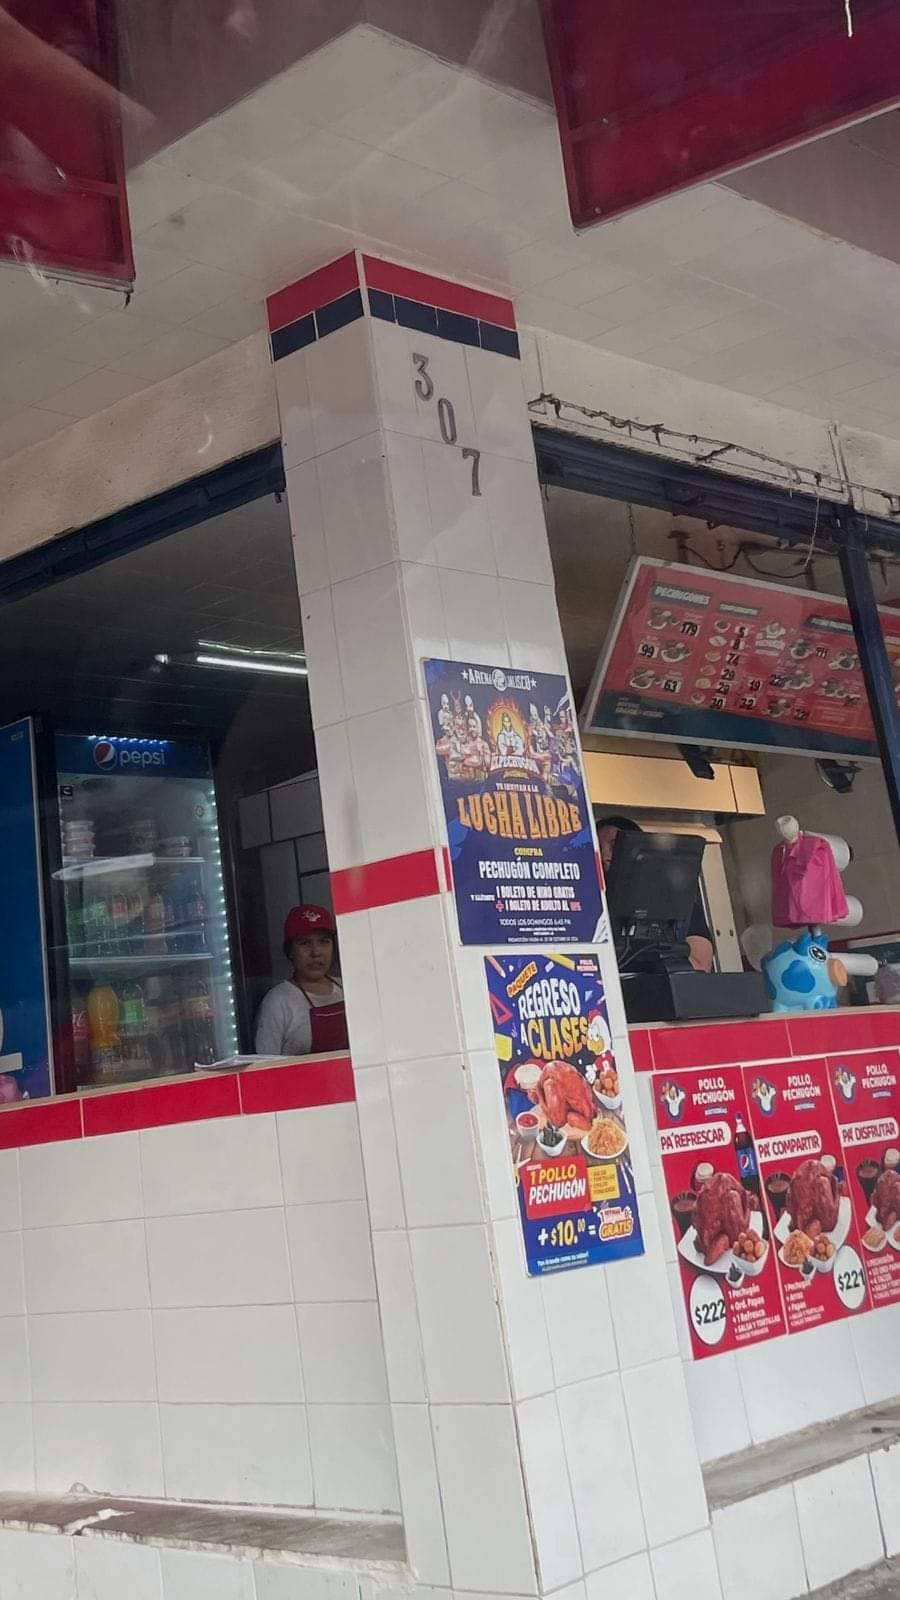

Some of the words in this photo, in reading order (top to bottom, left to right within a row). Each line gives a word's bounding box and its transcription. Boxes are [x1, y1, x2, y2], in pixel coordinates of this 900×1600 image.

[681, 622, 698, 636] 179
[641, 644, 655, 658] 99
[469, 668, 493, 685] ARENA
[664, 680, 678, 693] 63
[119, 746, 165, 768] pepsi
[457, 791, 528, 839] LUCHA
[525, 792, 583, 839] LIBRE
[479, 857, 531, 879] PECHUGÓN
[532, 862, 580, 880] COMPLETO
[526, 886, 536, 898] DE
[532, 900, 540, 911] DE
[509, 963, 537, 995] PAQUETE
[518, 978, 580, 1020] REGRESO
[520, 1023, 528, 1046] A
[528, 1017, 589, 1060] CLASES
[866, 1063, 889, 1076] POLLO
[698, 1076, 725, 1090] POLLO
[787, 1074, 812, 1087] POLLO
[675, 1128, 725, 1148] REFRESCAR
[855, 1122, 896, 1140] DISFRUTAR
[772, 1135, 820, 1155] COMPARTIR
[530, 1171, 536, 1185] 1
[539, 1164, 577, 1184] POLLO
[528, 1178, 586, 1206] PECHUGÓN
[602, 1219, 632, 1239] GRATIS
[838, 1269, 865, 1292] $221
[695, 1299, 726, 1326] $222
[740, 1309, 766, 1322] Refresco
